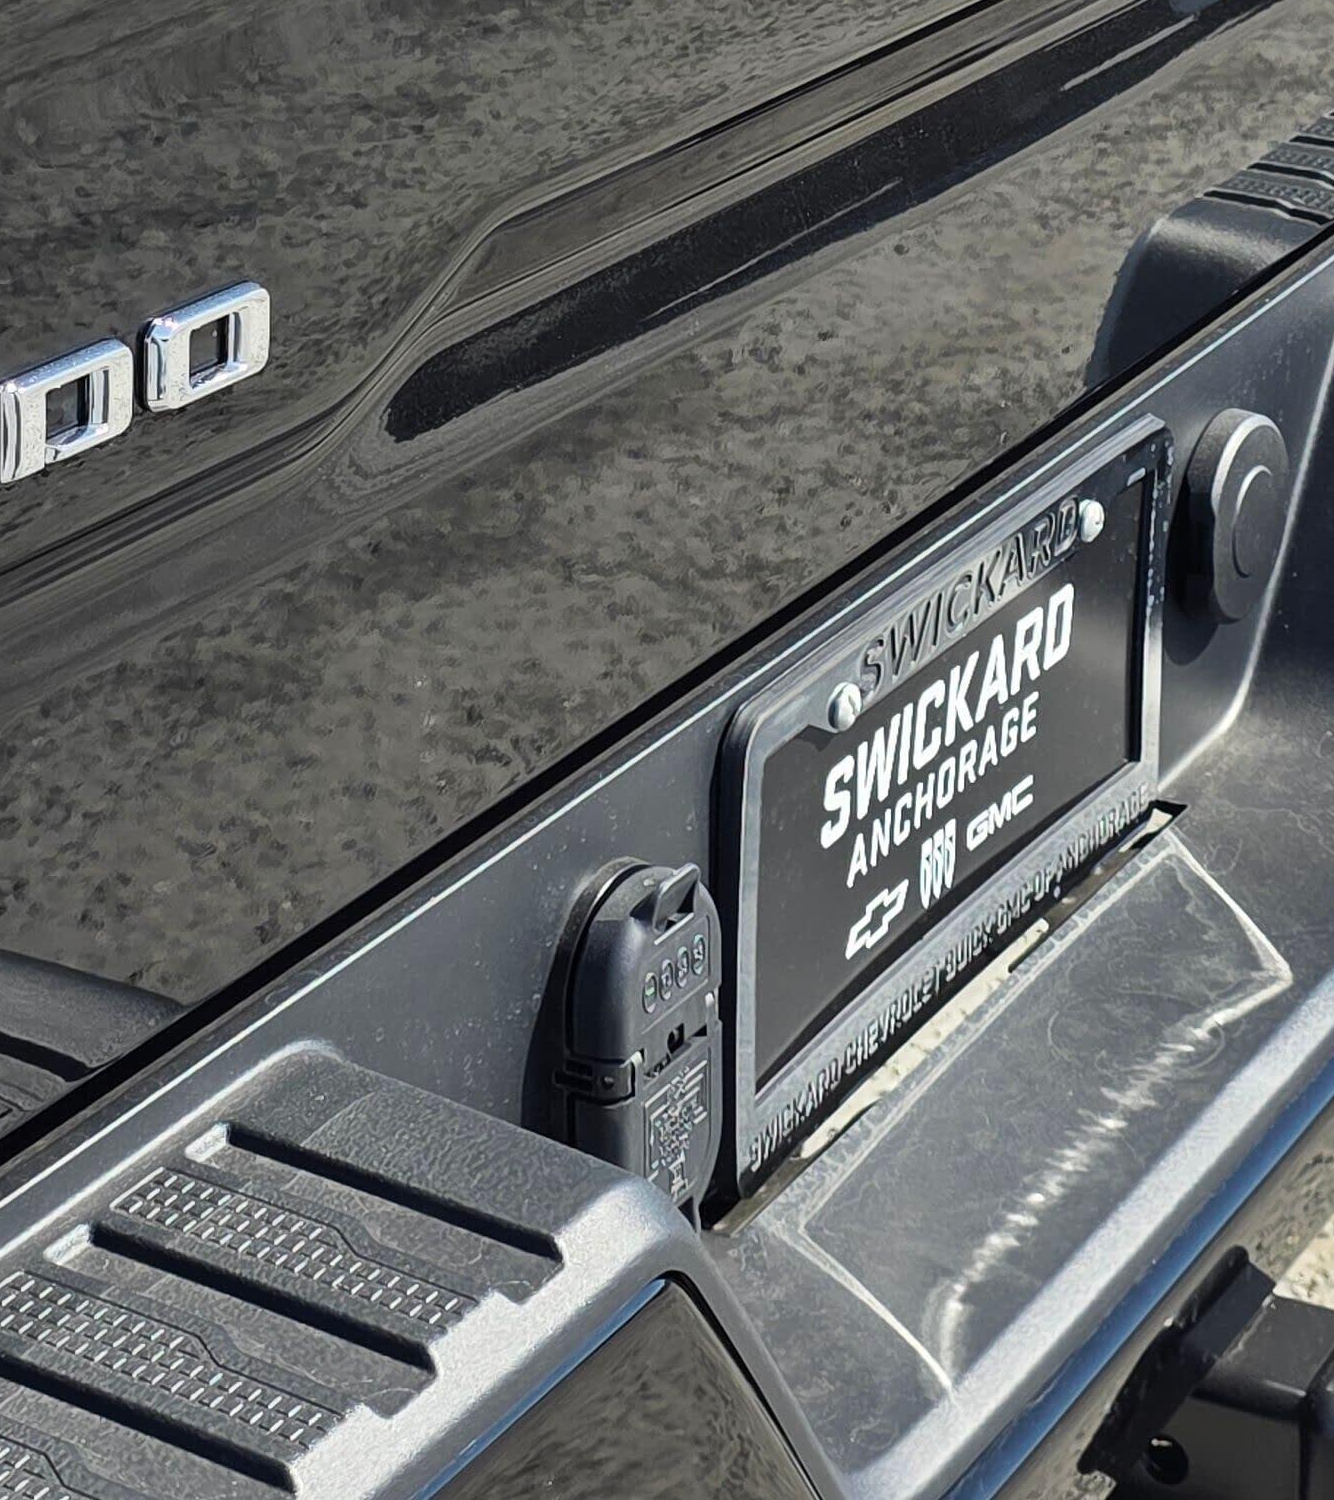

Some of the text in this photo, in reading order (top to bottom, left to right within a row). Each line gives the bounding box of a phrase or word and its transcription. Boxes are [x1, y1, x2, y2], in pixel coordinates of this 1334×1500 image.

[859, 496, 1081, 701] SWICKARD
[820, 582, 1075, 849] SWICKARD
[846, 691, 1040, 889] ANCHORAGE
[966, 774, 1034, 852] GMC
